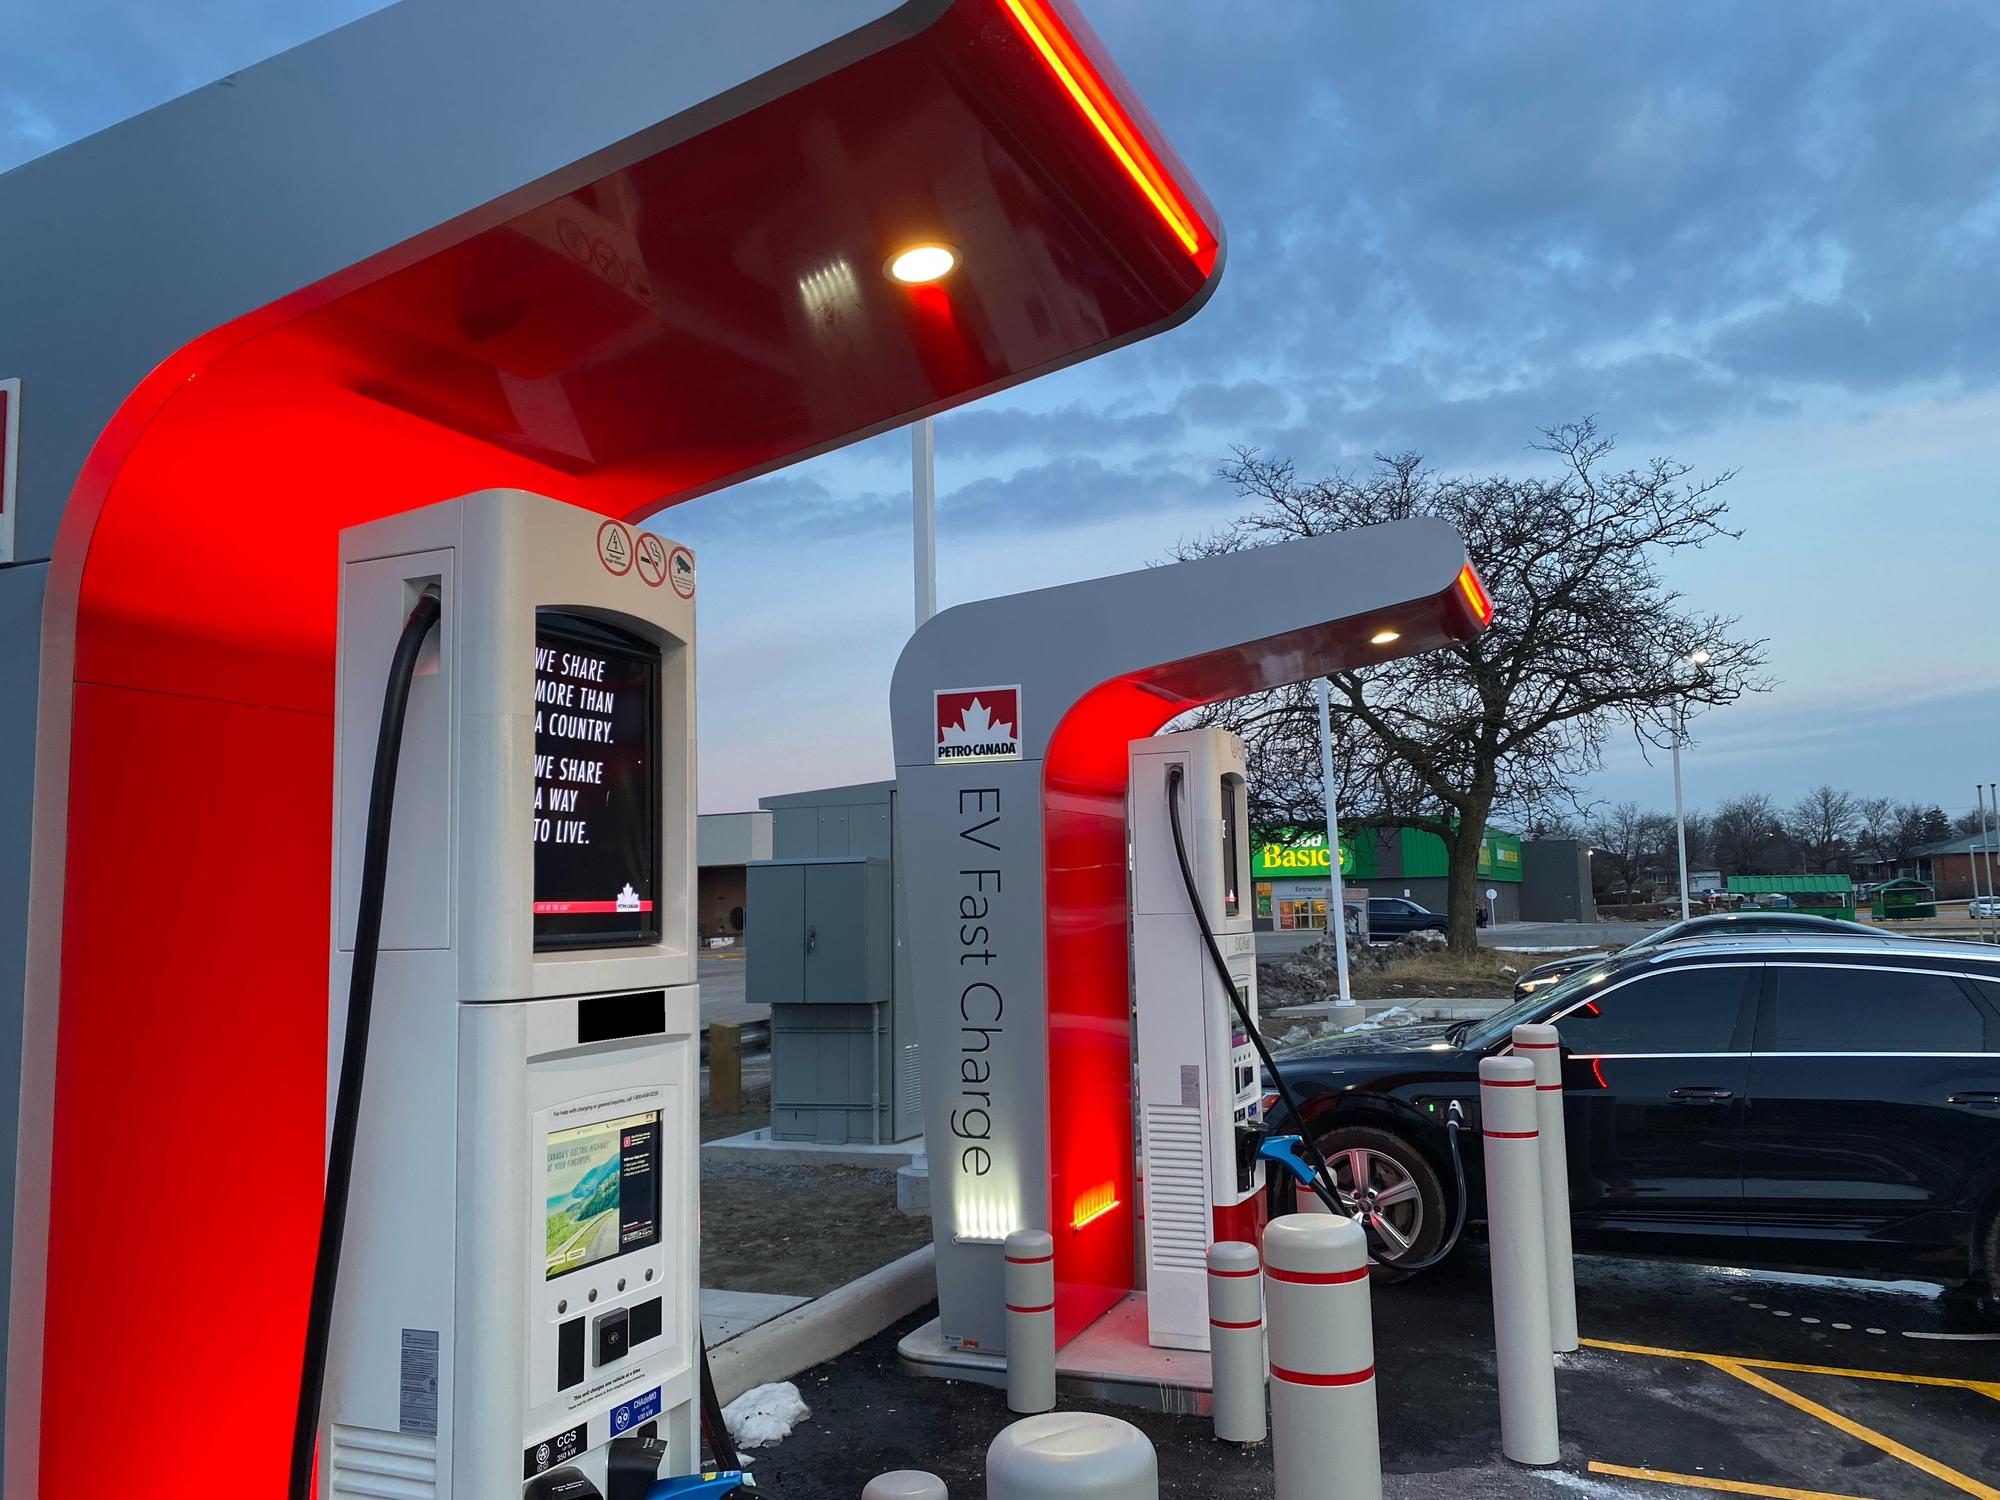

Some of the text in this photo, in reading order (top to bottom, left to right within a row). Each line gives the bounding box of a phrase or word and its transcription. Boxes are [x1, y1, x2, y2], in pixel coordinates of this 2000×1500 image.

[535, 647, 606, 683] WE SHARE
[534, 679, 614, 714] MORE THAN
[534, 710, 614, 744] A COUNTRY.
[534, 754, 604, 784] WE SHARE
[534, 786, 578, 812] A WAY
[533, 818, 590, 844] TO LIVE.
[950, 788, 1003, 1177] EV Fast Charge
[637, 1409, 654, 1421] 100 kW
[557, 1430, 577, 1448] CCS
[556, 1446, 577, 1462] 350 kW
